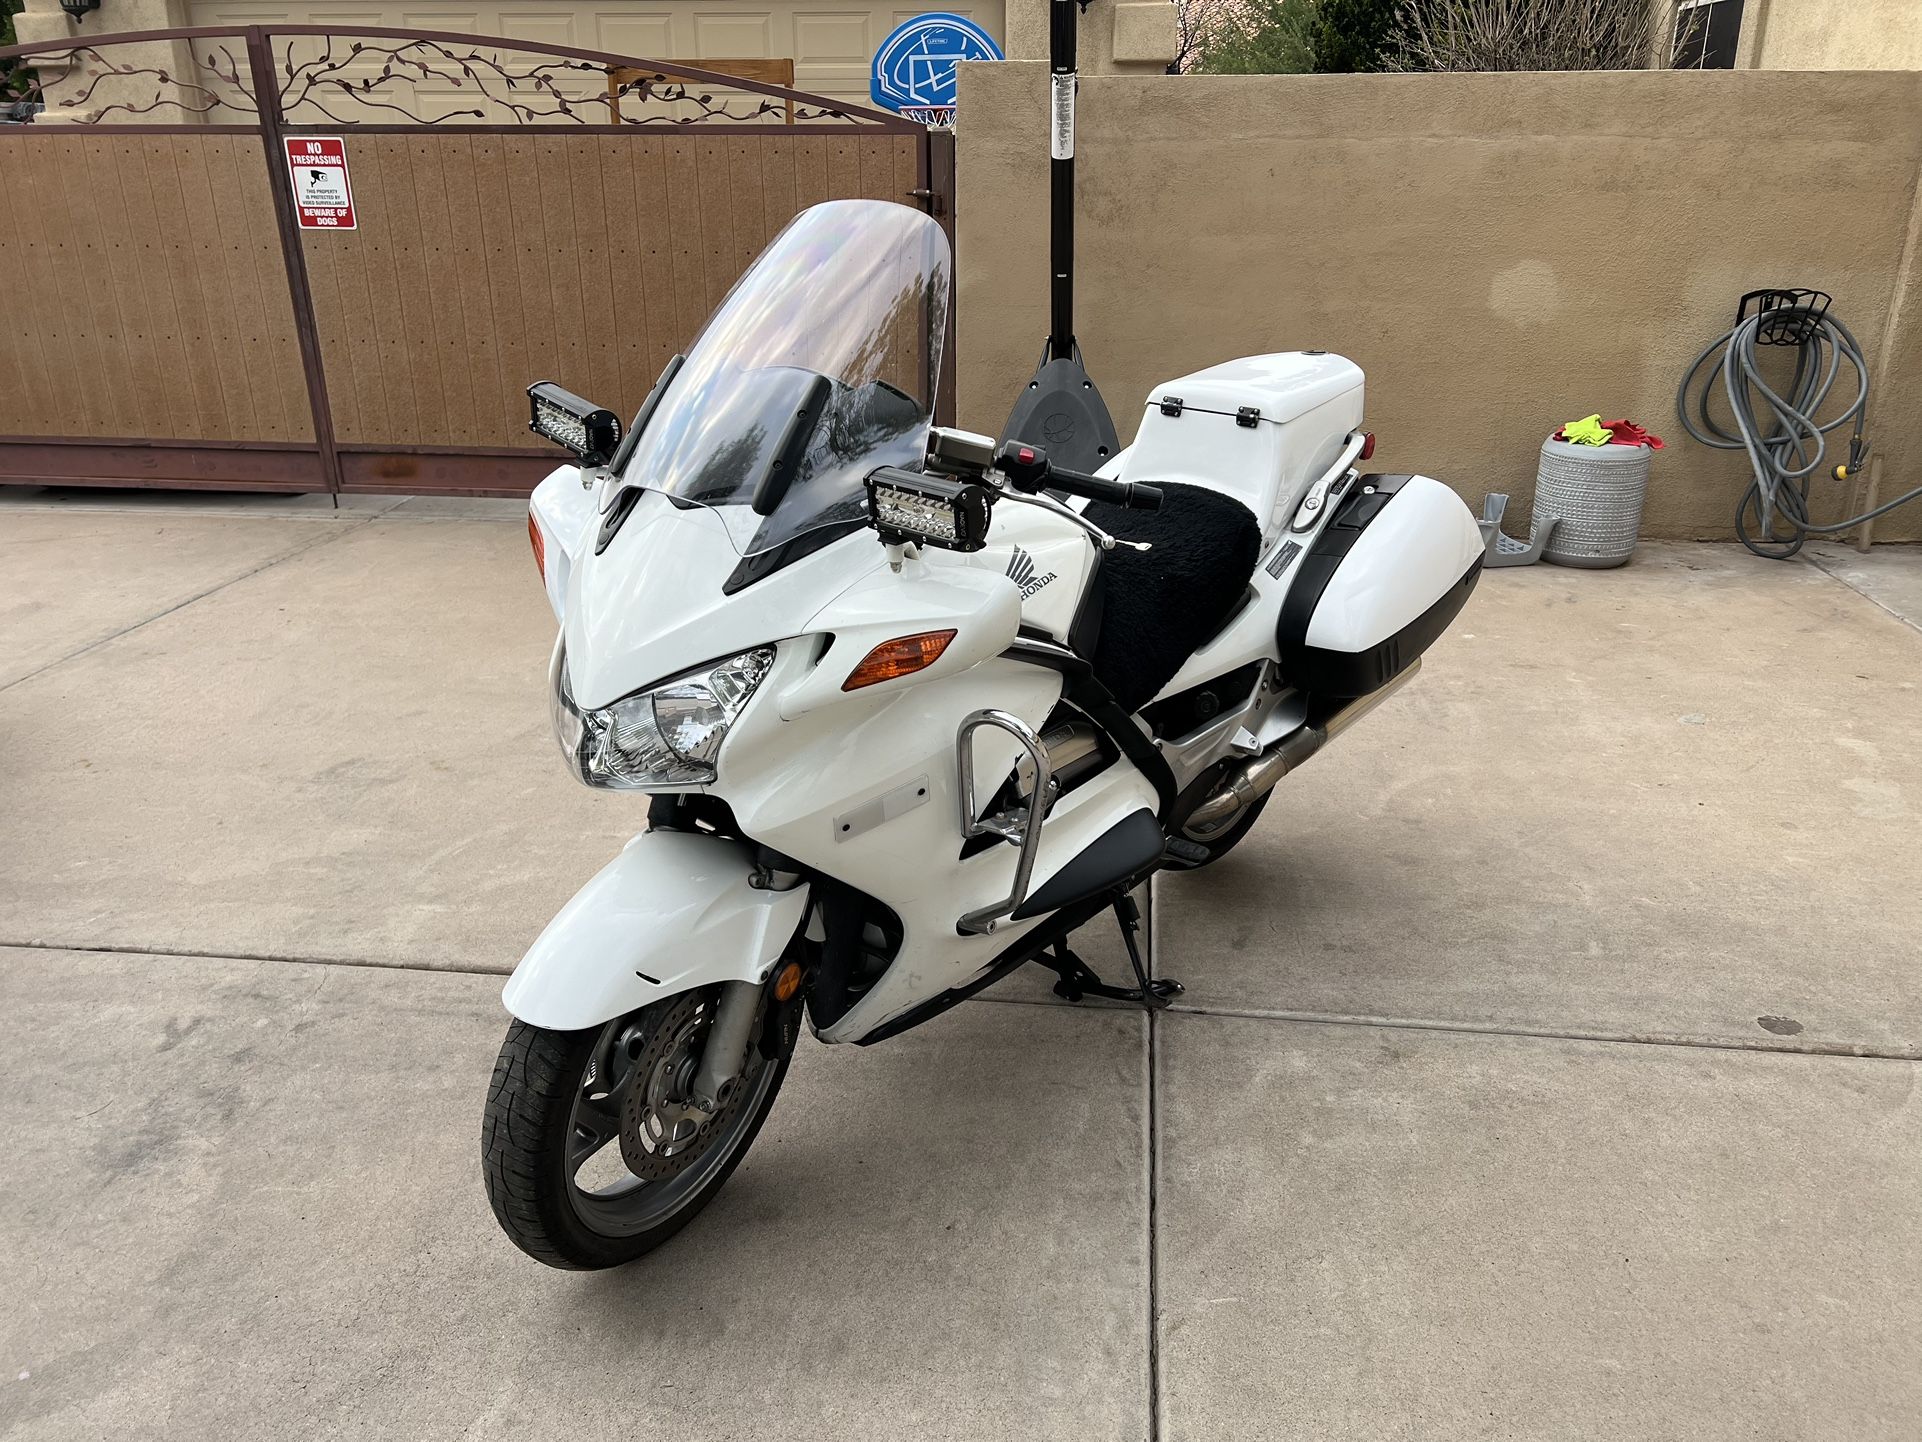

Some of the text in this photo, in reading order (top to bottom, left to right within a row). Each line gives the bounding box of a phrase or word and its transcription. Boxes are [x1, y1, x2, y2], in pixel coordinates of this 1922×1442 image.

[306, 142, 322, 154] NO
[292, 155, 342, 165] TRESPASSING
[303, 208, 348, 217] BEWARE OF
[317, 217, 338, 226] DOGS
[1020, 571, 1058, 602] HONDA
